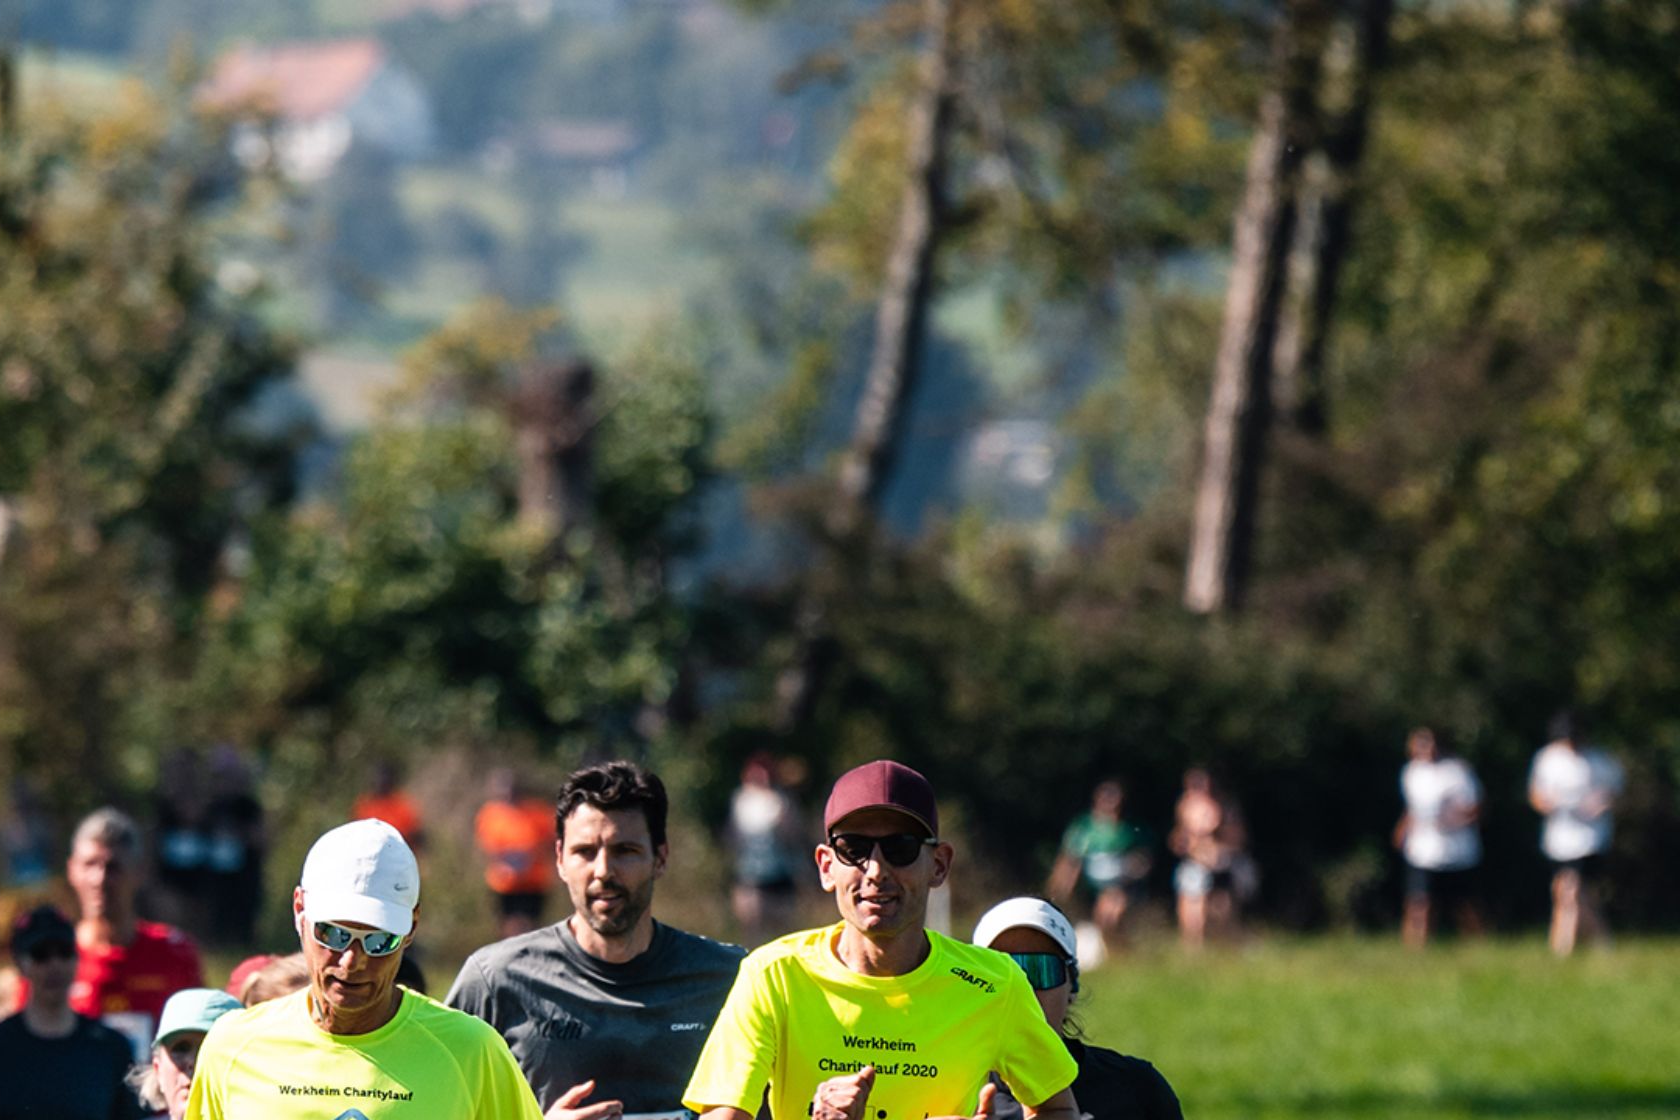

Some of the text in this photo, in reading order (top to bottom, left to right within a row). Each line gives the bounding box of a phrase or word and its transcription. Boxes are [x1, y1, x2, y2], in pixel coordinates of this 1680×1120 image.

[950, 967, 988, 988] CRAFT
[843, 1035, 916, 1052] Werkheim
[818, 1058, 938, 1078] Charitlauf 2020
[279, 1085, 413, 1101] Werkheim Charitylauf
